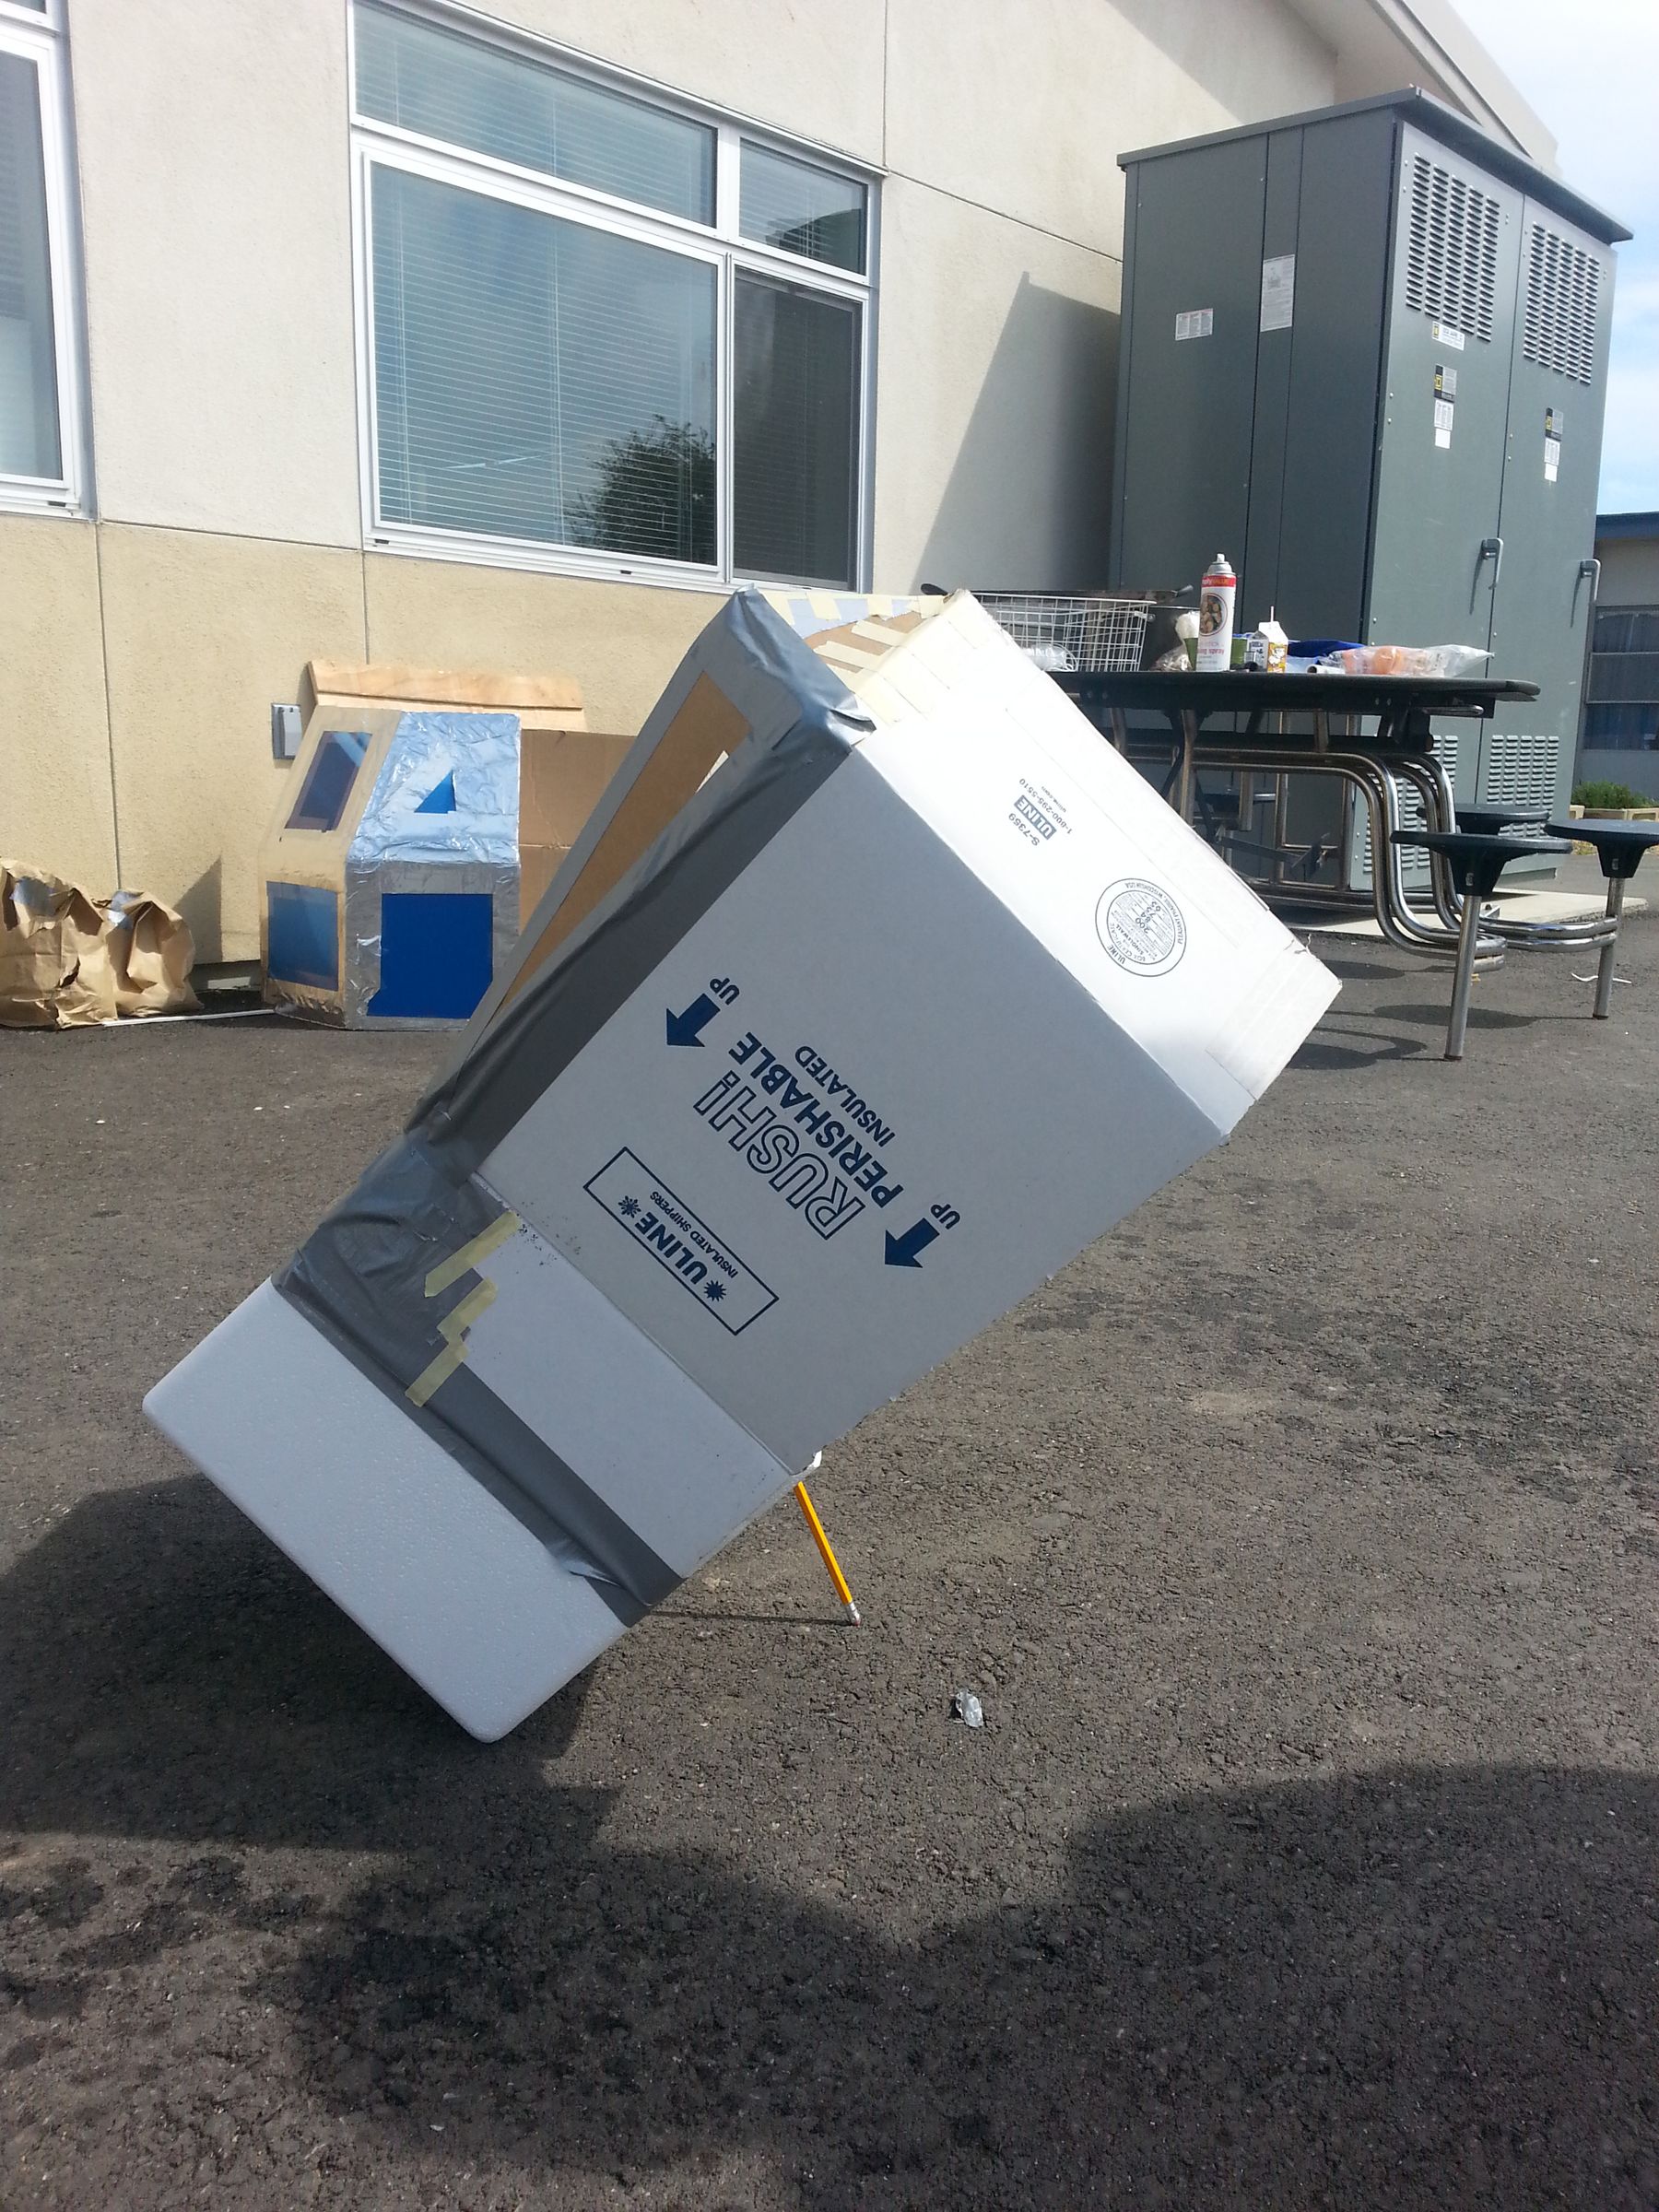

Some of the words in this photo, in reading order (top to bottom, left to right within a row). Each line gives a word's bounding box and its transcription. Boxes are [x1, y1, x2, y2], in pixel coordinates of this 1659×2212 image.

[1009, 813, 1040, 846] S-7359
[1015, 795, 1055, 839] ULINE
[1135, 917, 1151, 933] 200
[1141, 912, 1151, 923] 84
[1151, 901, 1161, 911] 65
[709, 977, 740, 1006] UP
[794, 1046, 895, 1147] INSULATED
[728, 1032, 904, 1209] PERISHABLE
[693, 1070, 866, 1240] RUSH!
[650, 1190, 692, 1233] SHIPPERS
[930, 1203, 961, 1230] UP
[635, 1211, 708, 1284] ULINE
[691, 1230, 738, 1278] INSULATED
